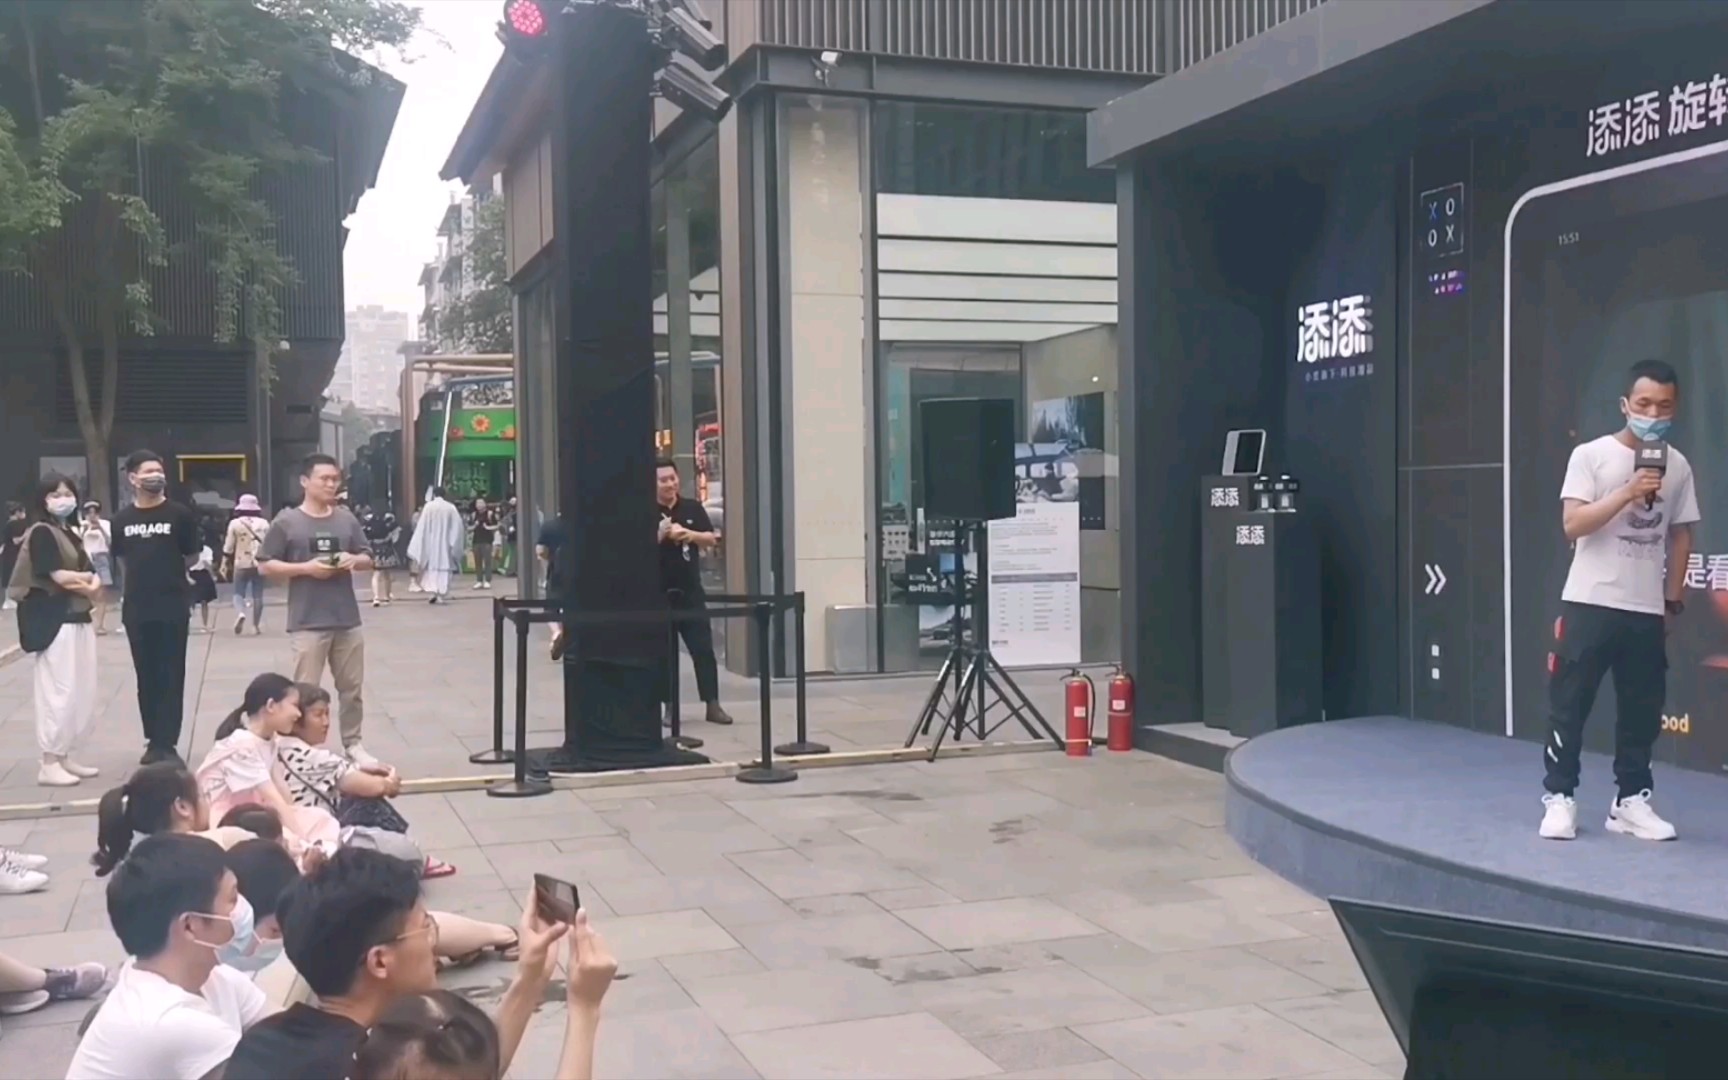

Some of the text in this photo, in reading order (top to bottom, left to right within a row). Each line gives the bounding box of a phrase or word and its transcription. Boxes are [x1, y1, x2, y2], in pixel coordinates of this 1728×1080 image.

[1586, 90, 1660, 157] 添添
[1297, 294, 1372, 363] 添添
[1211, 487, 1240, 507] 添添
[124, 522, 171, 537] ENGAGE
[1236, 525, 1265, 545] 添添
